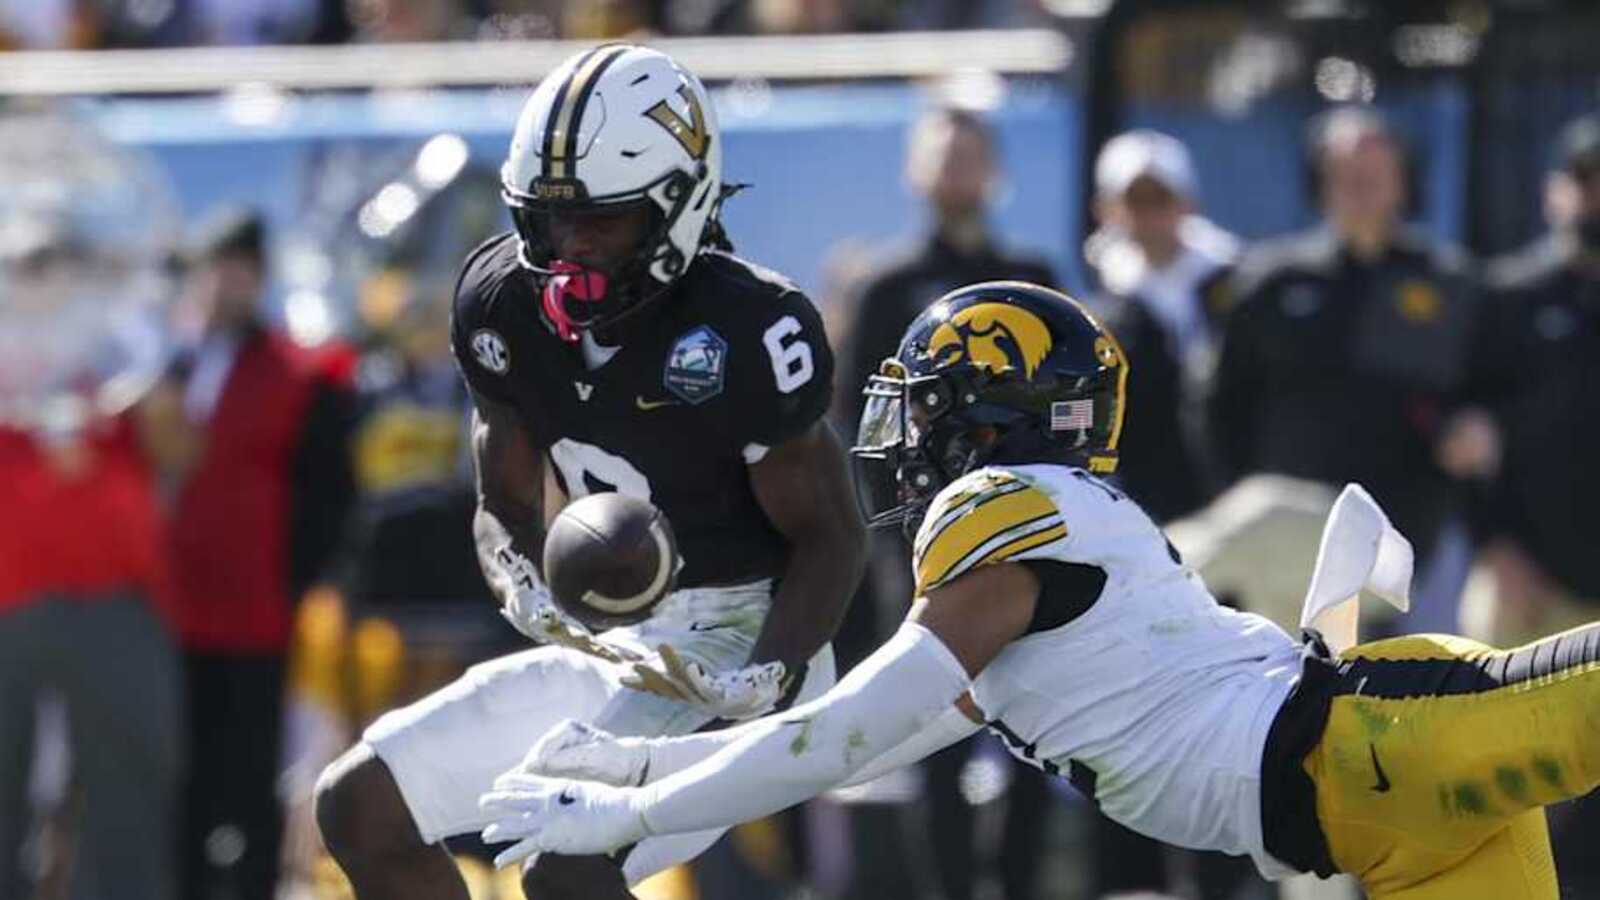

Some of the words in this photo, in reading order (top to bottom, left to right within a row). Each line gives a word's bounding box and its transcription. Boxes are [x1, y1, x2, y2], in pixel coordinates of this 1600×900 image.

[643, 84, 710, 160] V
[472, 332, 508, 372] SEC
[763, 315, 814, 394] 6
[574, 381, 594, 401] V
